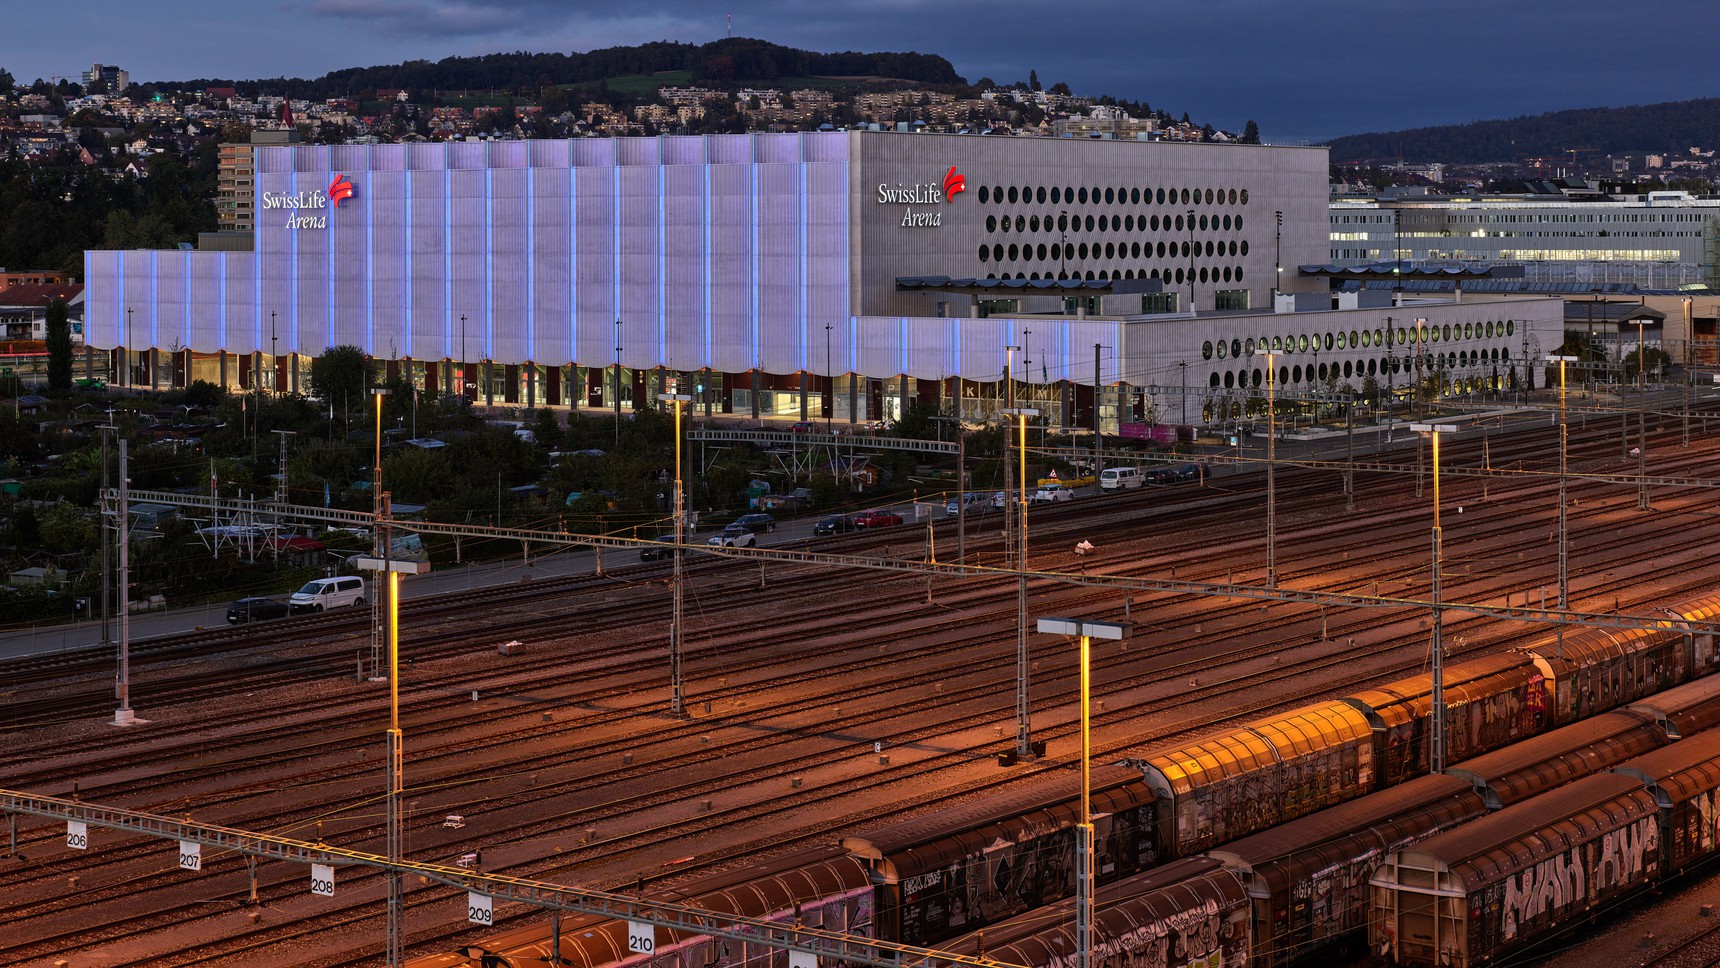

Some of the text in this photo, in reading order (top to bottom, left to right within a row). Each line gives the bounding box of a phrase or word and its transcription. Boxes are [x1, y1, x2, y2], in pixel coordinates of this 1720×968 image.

[263, 190, 326, 209] SwissLife
[879, 182, 940, 204] SwissLife
[285, 211, 327, 229] Arena
[901, 207, 941, 227] Arena
[888, 384, 895, 393] P
[966, 387, 975, 397] K
[68, 833, 86, 847] 206
[180, 853, 199, 868] 207
[312, 879, 333, 894] 208
[469, 906, 492, 922] 209
[630, 935, 652, 951] 210
